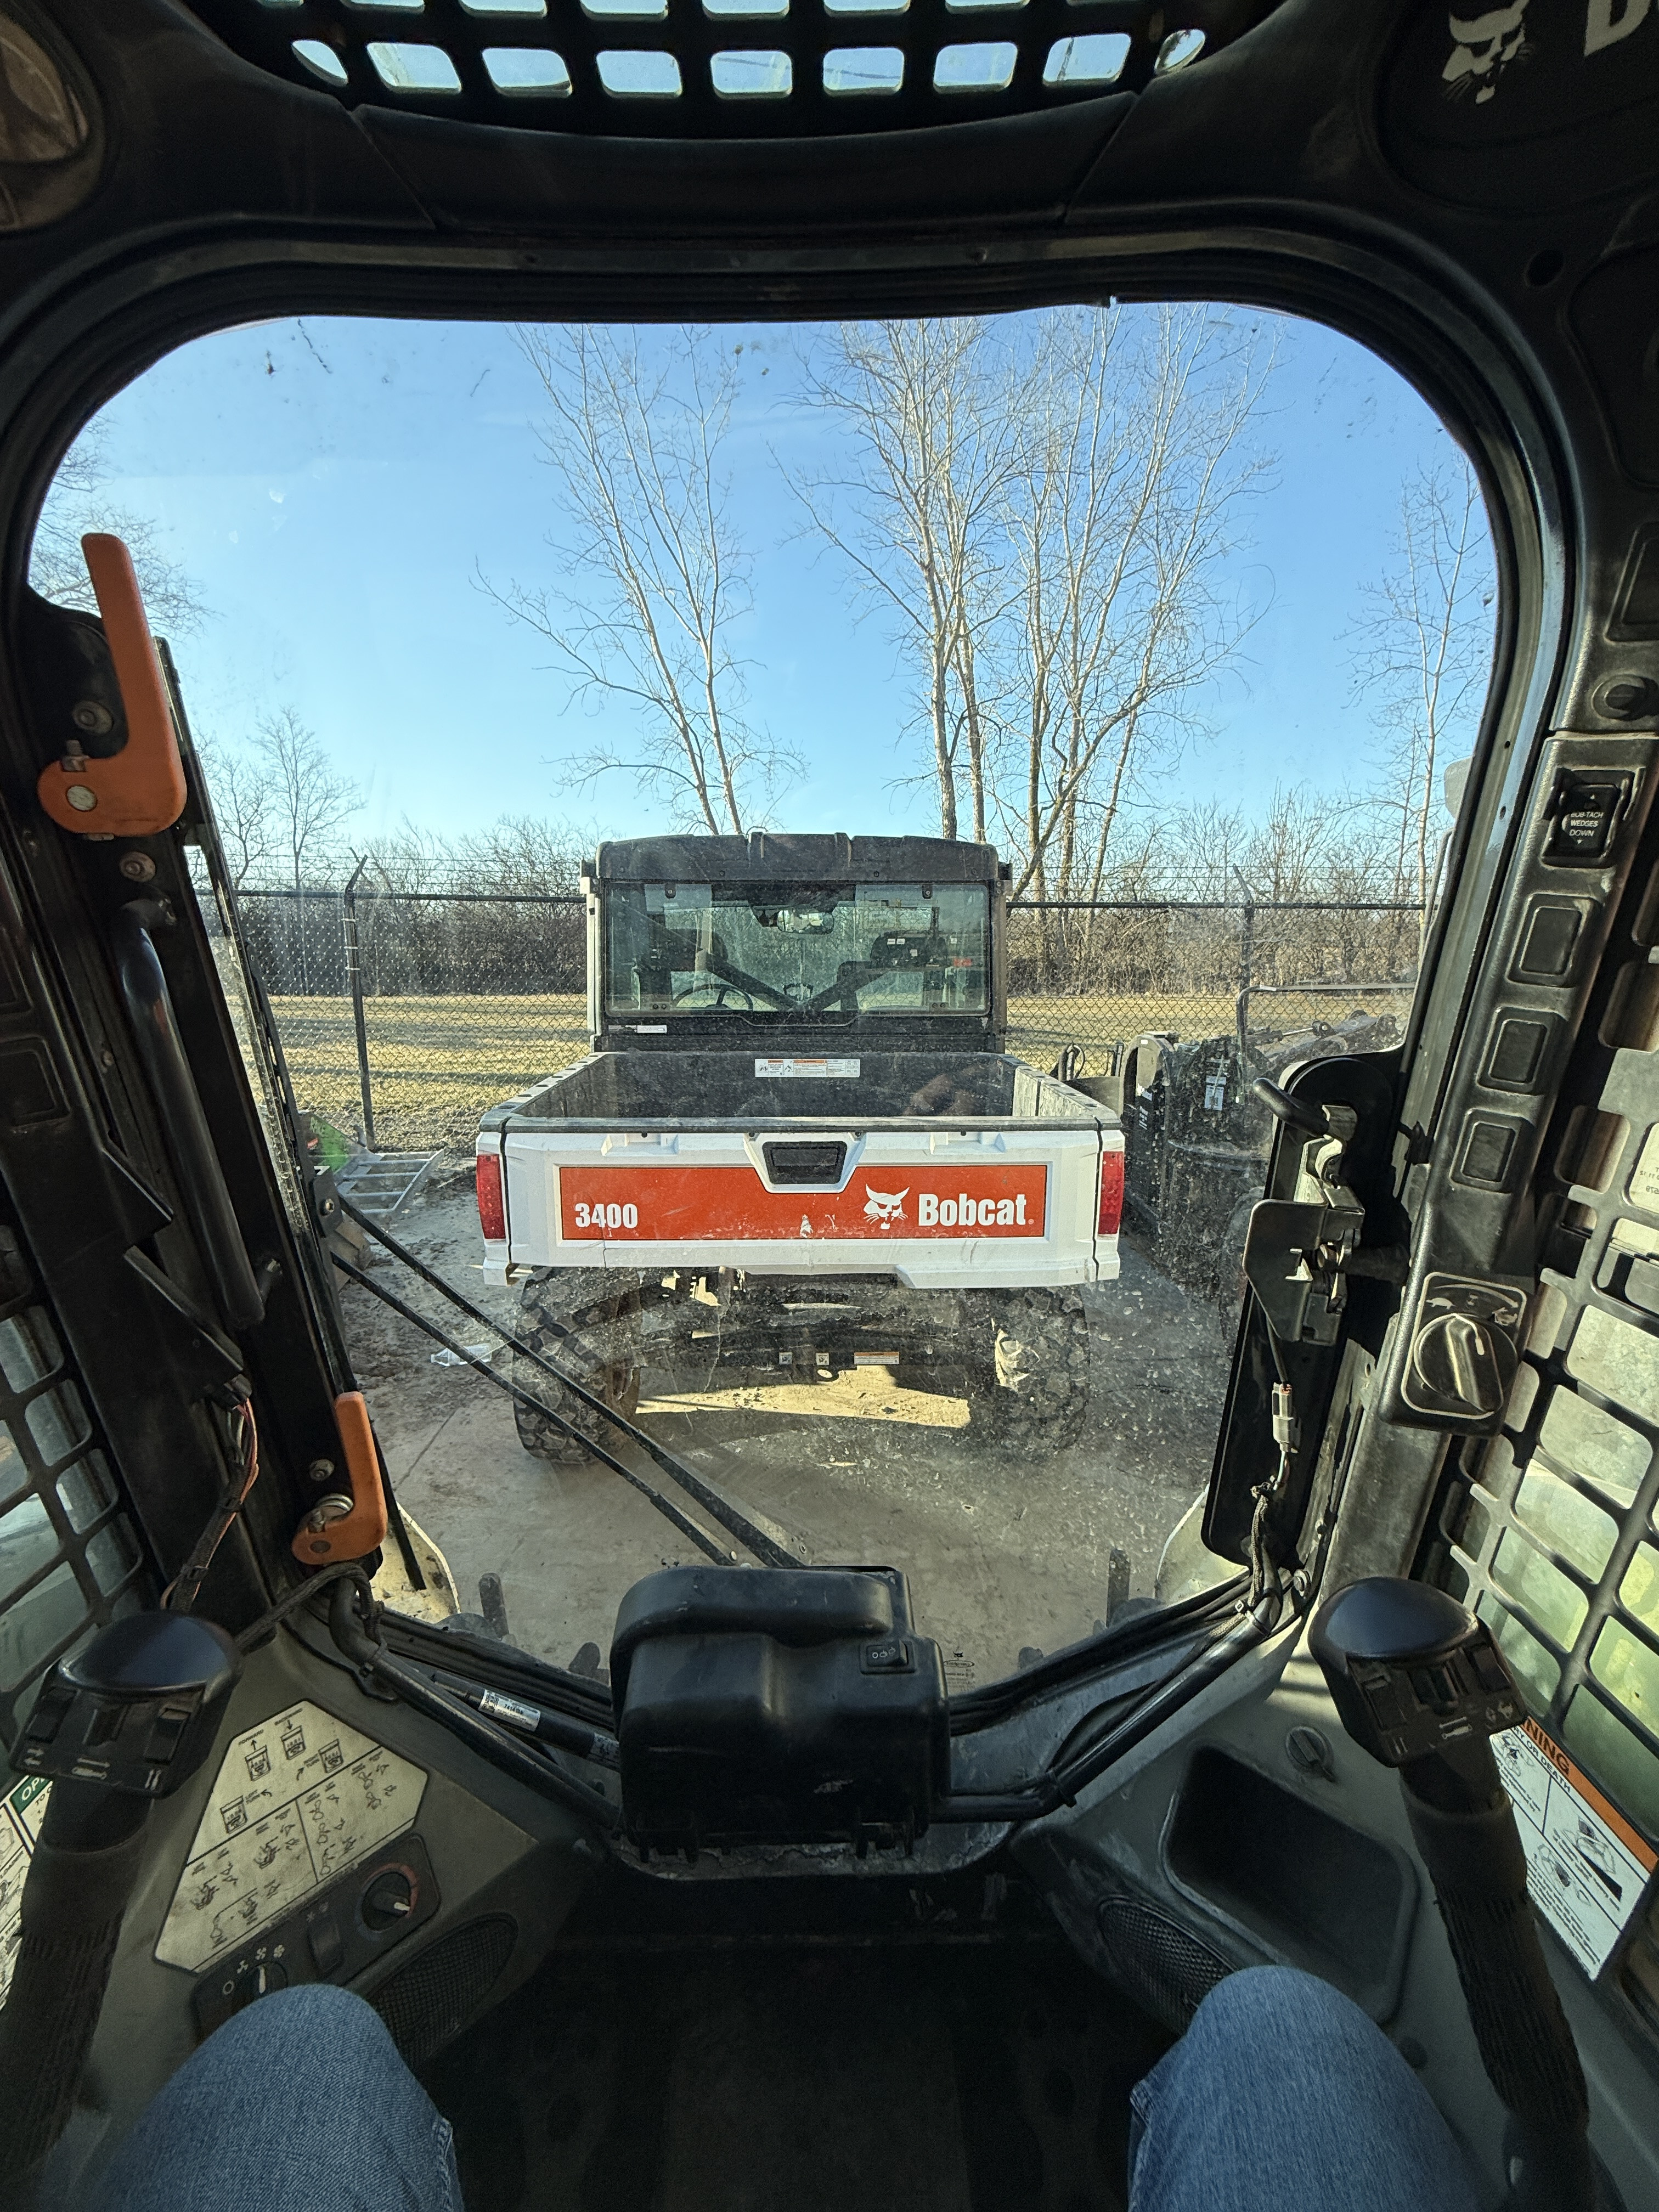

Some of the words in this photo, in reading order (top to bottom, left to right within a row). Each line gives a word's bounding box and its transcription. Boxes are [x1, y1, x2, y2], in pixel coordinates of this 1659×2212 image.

[575, 1203, 637, 1228] 3400
[918, 1193, 1026, 1226] Bobcat
[1523, 1718, 1570, 1775] NING
[1526, 1740, 1539, 1757] OR
[1541, 1756, 1571, 1793] DEATH
